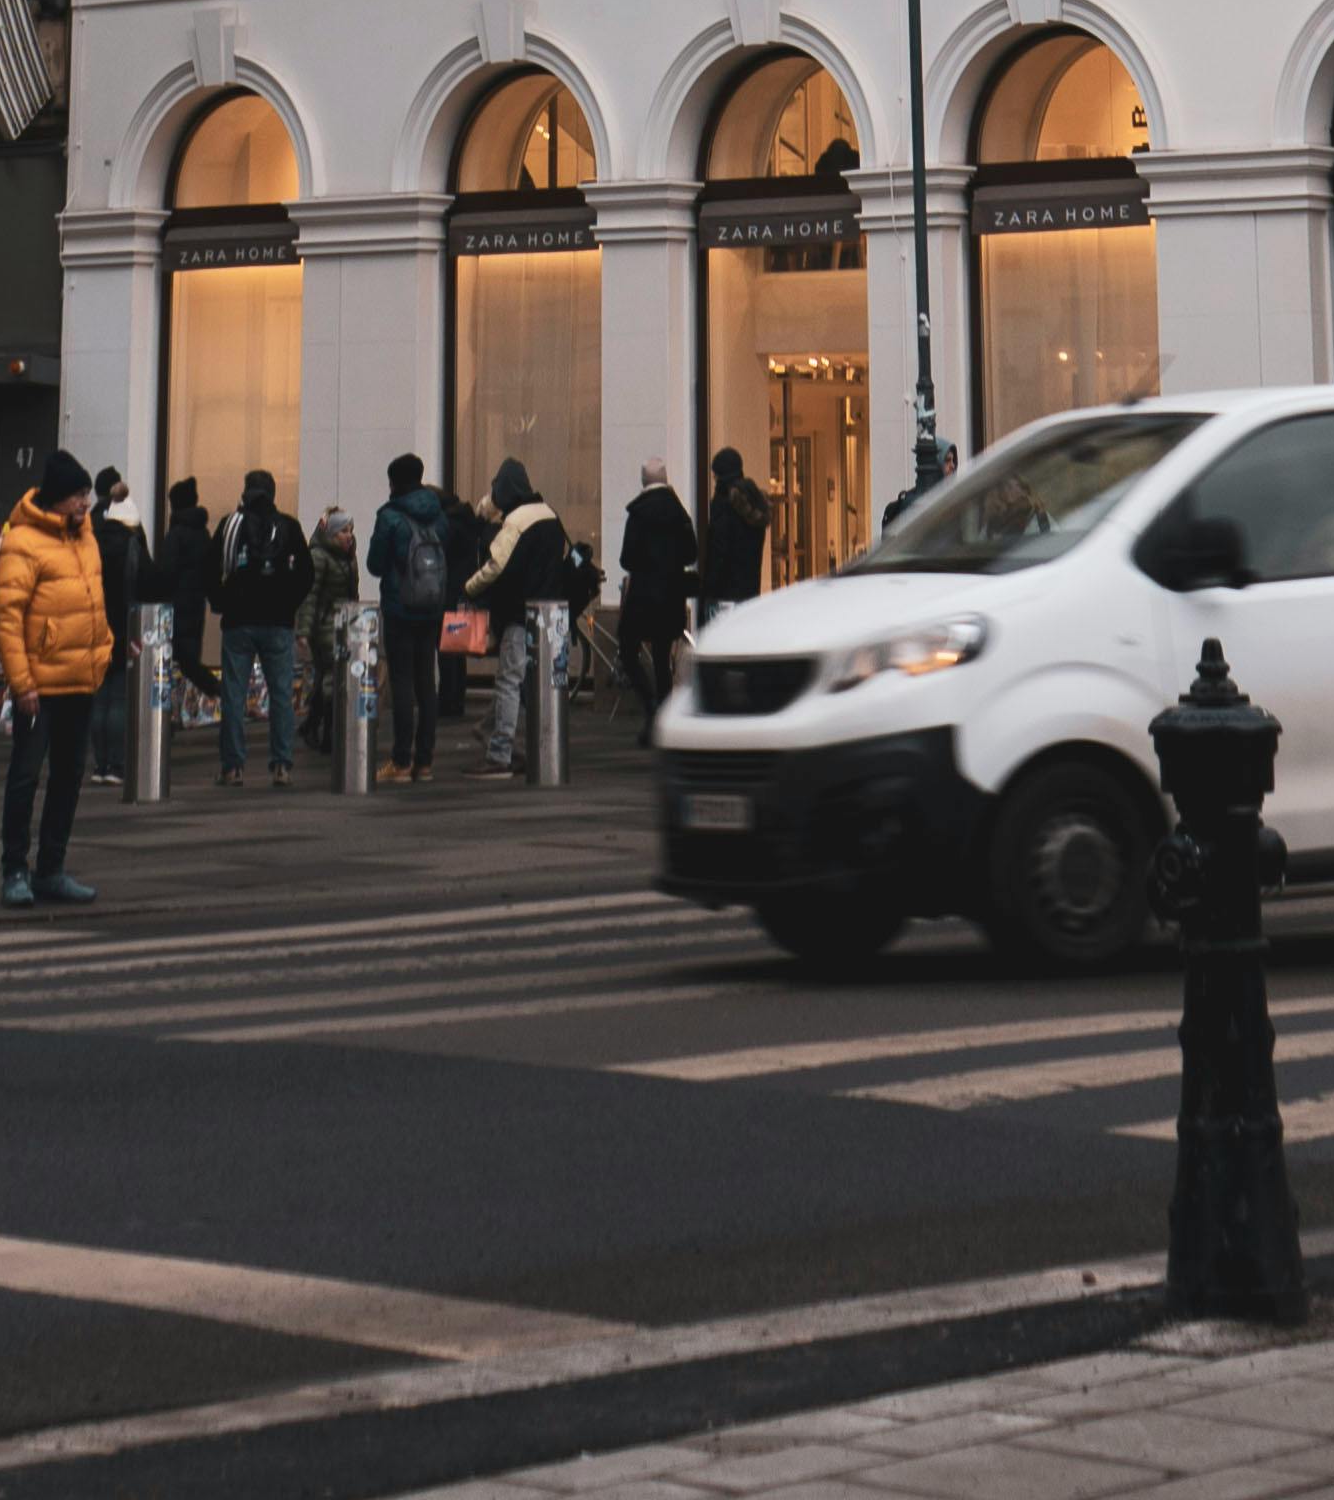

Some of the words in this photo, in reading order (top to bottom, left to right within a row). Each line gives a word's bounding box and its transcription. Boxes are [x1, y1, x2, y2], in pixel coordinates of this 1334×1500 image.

[995, 210, 1054, 226] ZARA
[1066, 204, 1130, 223] HOME
[466, 235, 518, 249] ZARA
[528, 231, 583, 246] HOME
[717, 225, 772, 241] ZARA
[783, 219, 844, 238] HOME
[180, 249, 226, 264] ZARA
[235, 246, 286, 260] HOME
[16, 447, 33, 468] 47
